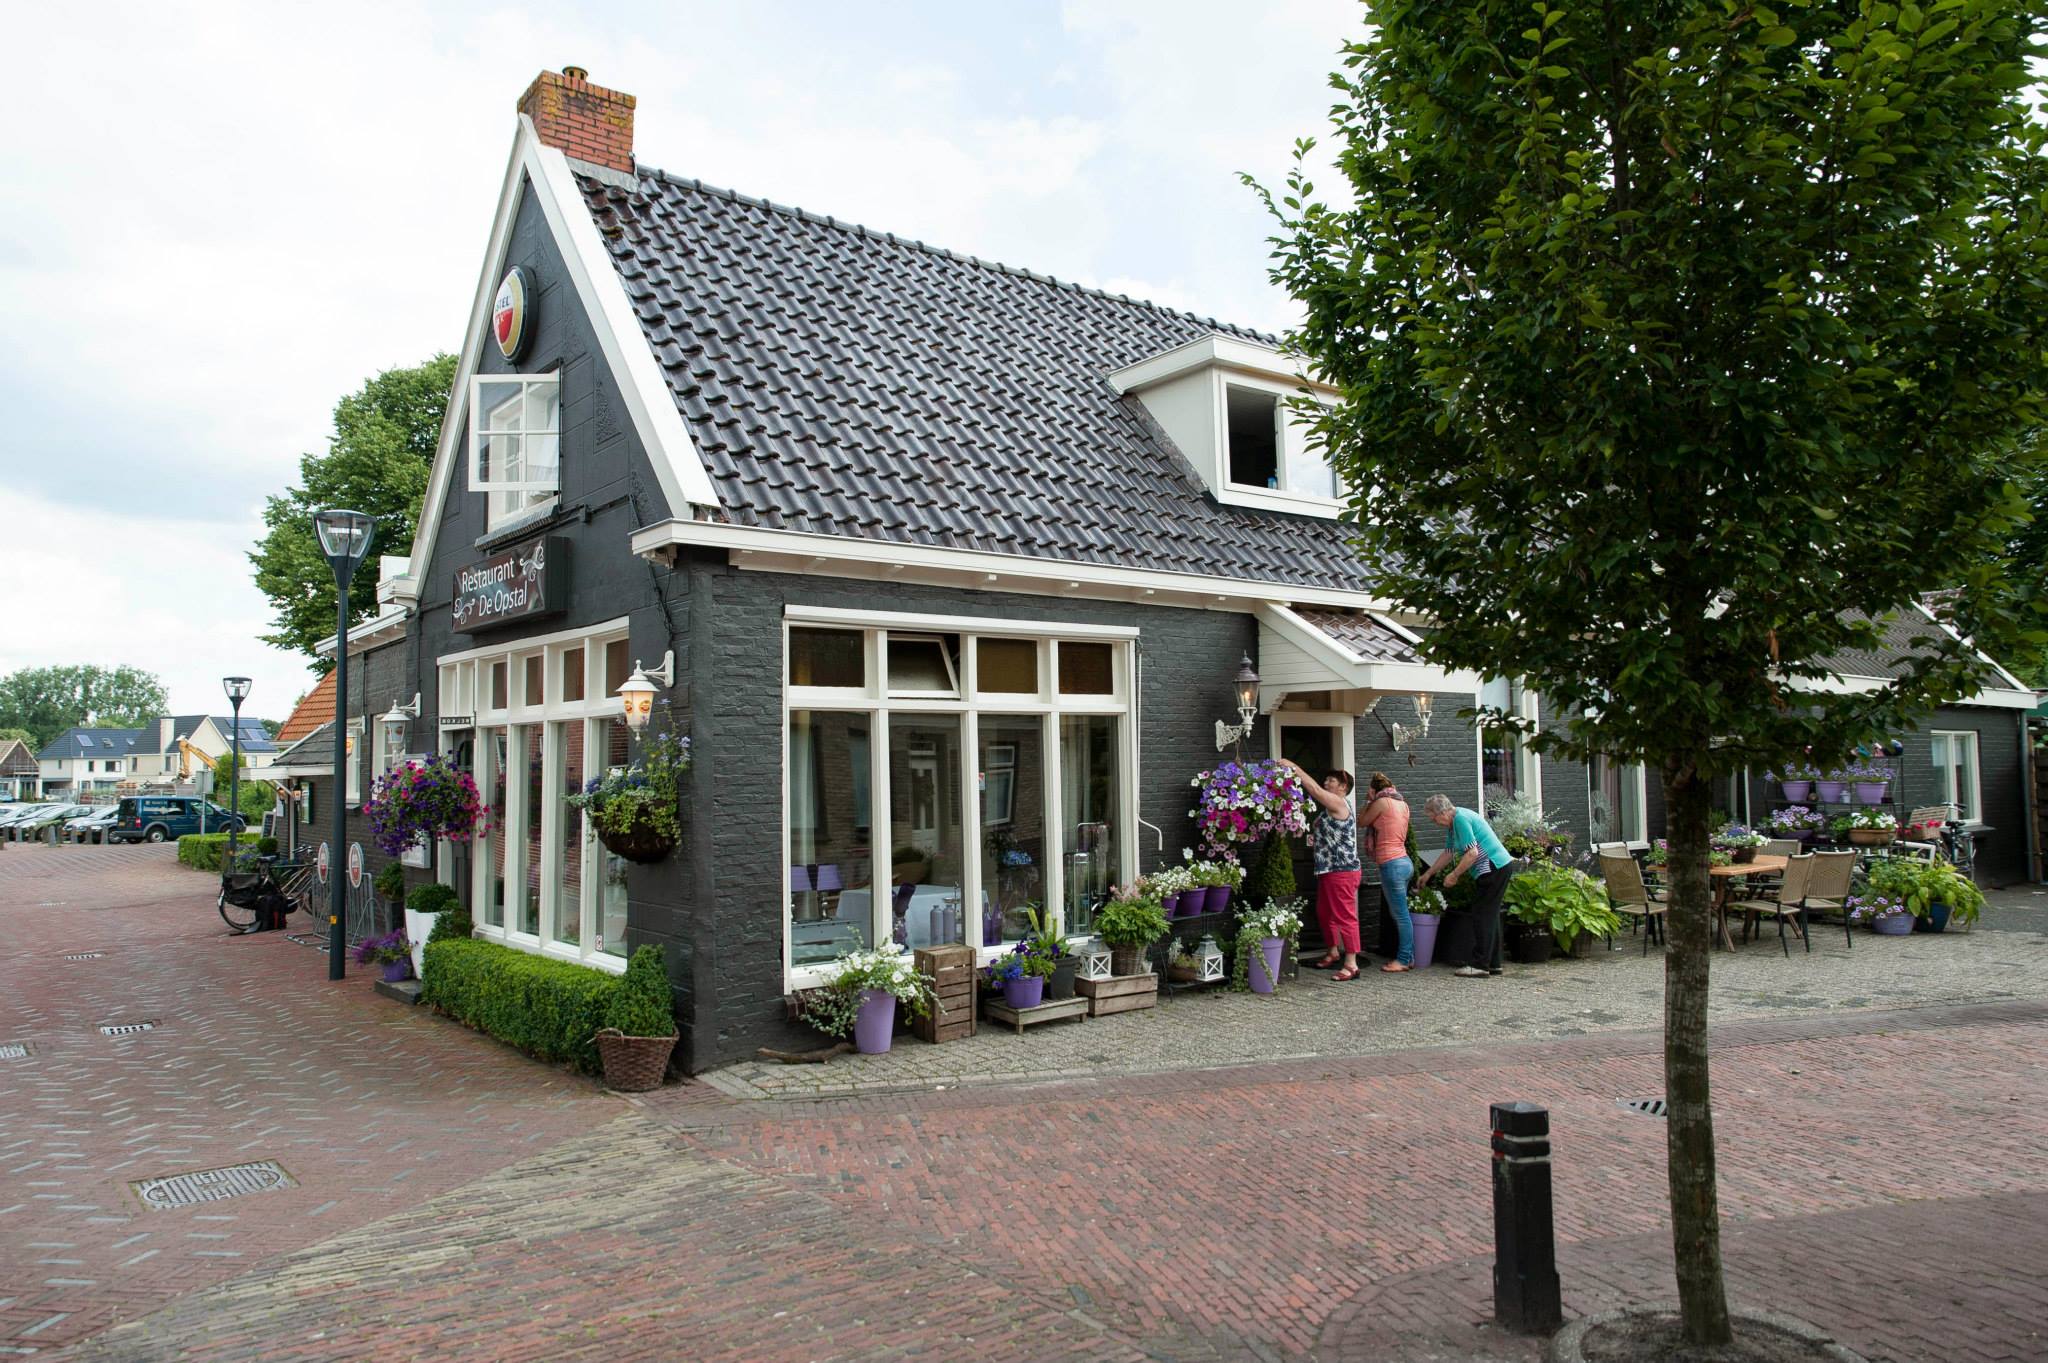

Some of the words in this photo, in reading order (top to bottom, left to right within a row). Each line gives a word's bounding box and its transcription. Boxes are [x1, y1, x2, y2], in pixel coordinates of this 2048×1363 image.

[462, 557, 515, 593] Restaurant
[479, 595, 492, 616] De
[494, 580, 527, 616] Opstal
